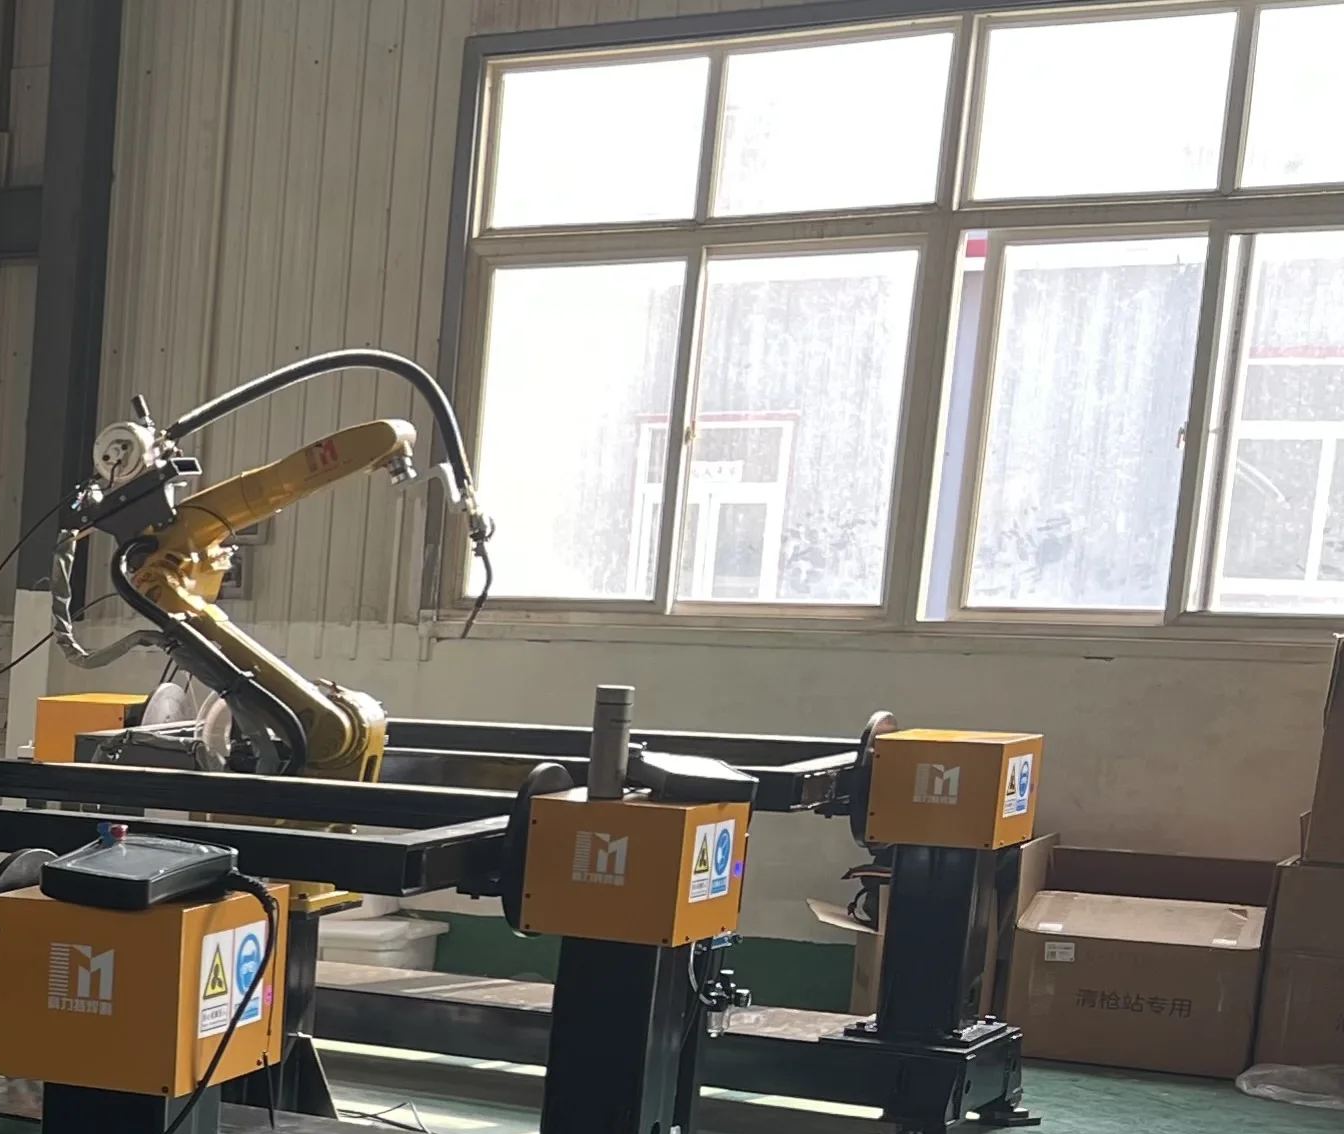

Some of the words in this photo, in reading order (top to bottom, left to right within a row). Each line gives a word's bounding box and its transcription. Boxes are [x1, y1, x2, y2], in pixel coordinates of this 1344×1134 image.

[1075, 987, 1193, 1018] 清枪站专用
